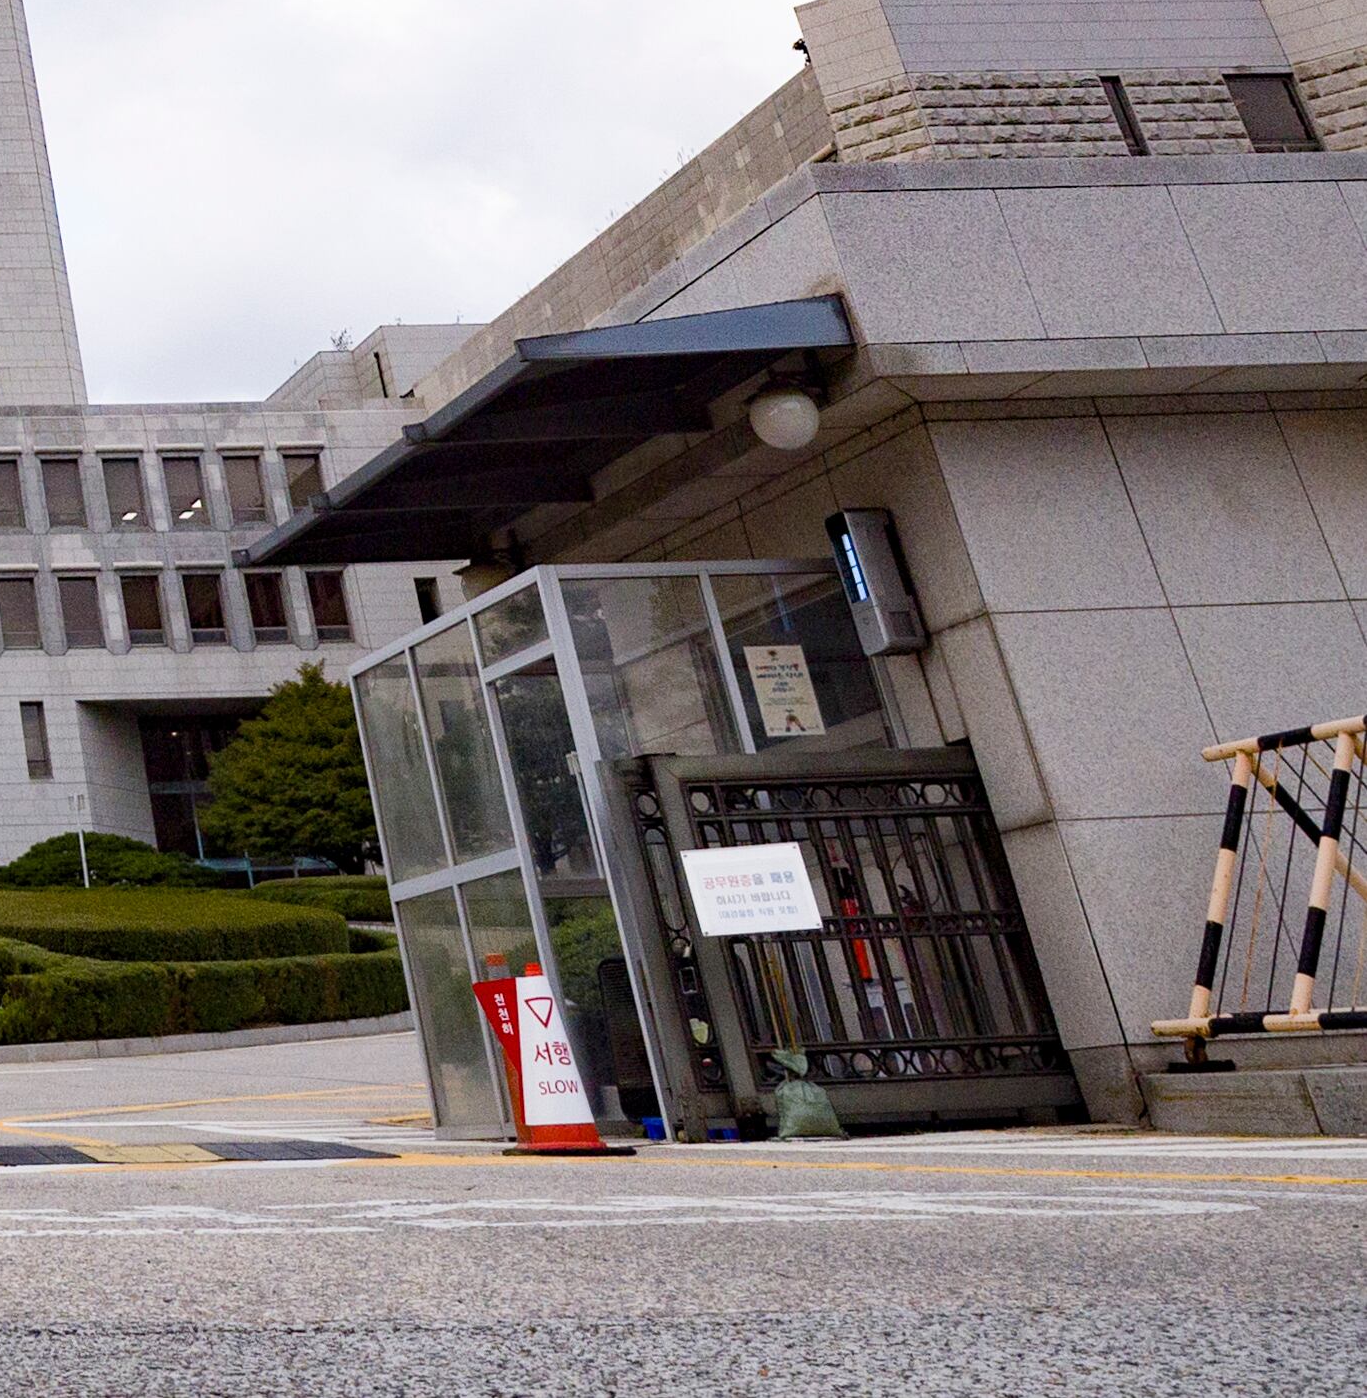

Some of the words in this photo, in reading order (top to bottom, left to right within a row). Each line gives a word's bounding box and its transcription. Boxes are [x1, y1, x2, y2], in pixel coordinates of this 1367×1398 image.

[703, 873, 764, 890] 공무원증을
[494, 993, 514, 1035] 천천히
[534, 1041, 571, 1066] 서행
[538, 1080, 579, 1095] SLOW
